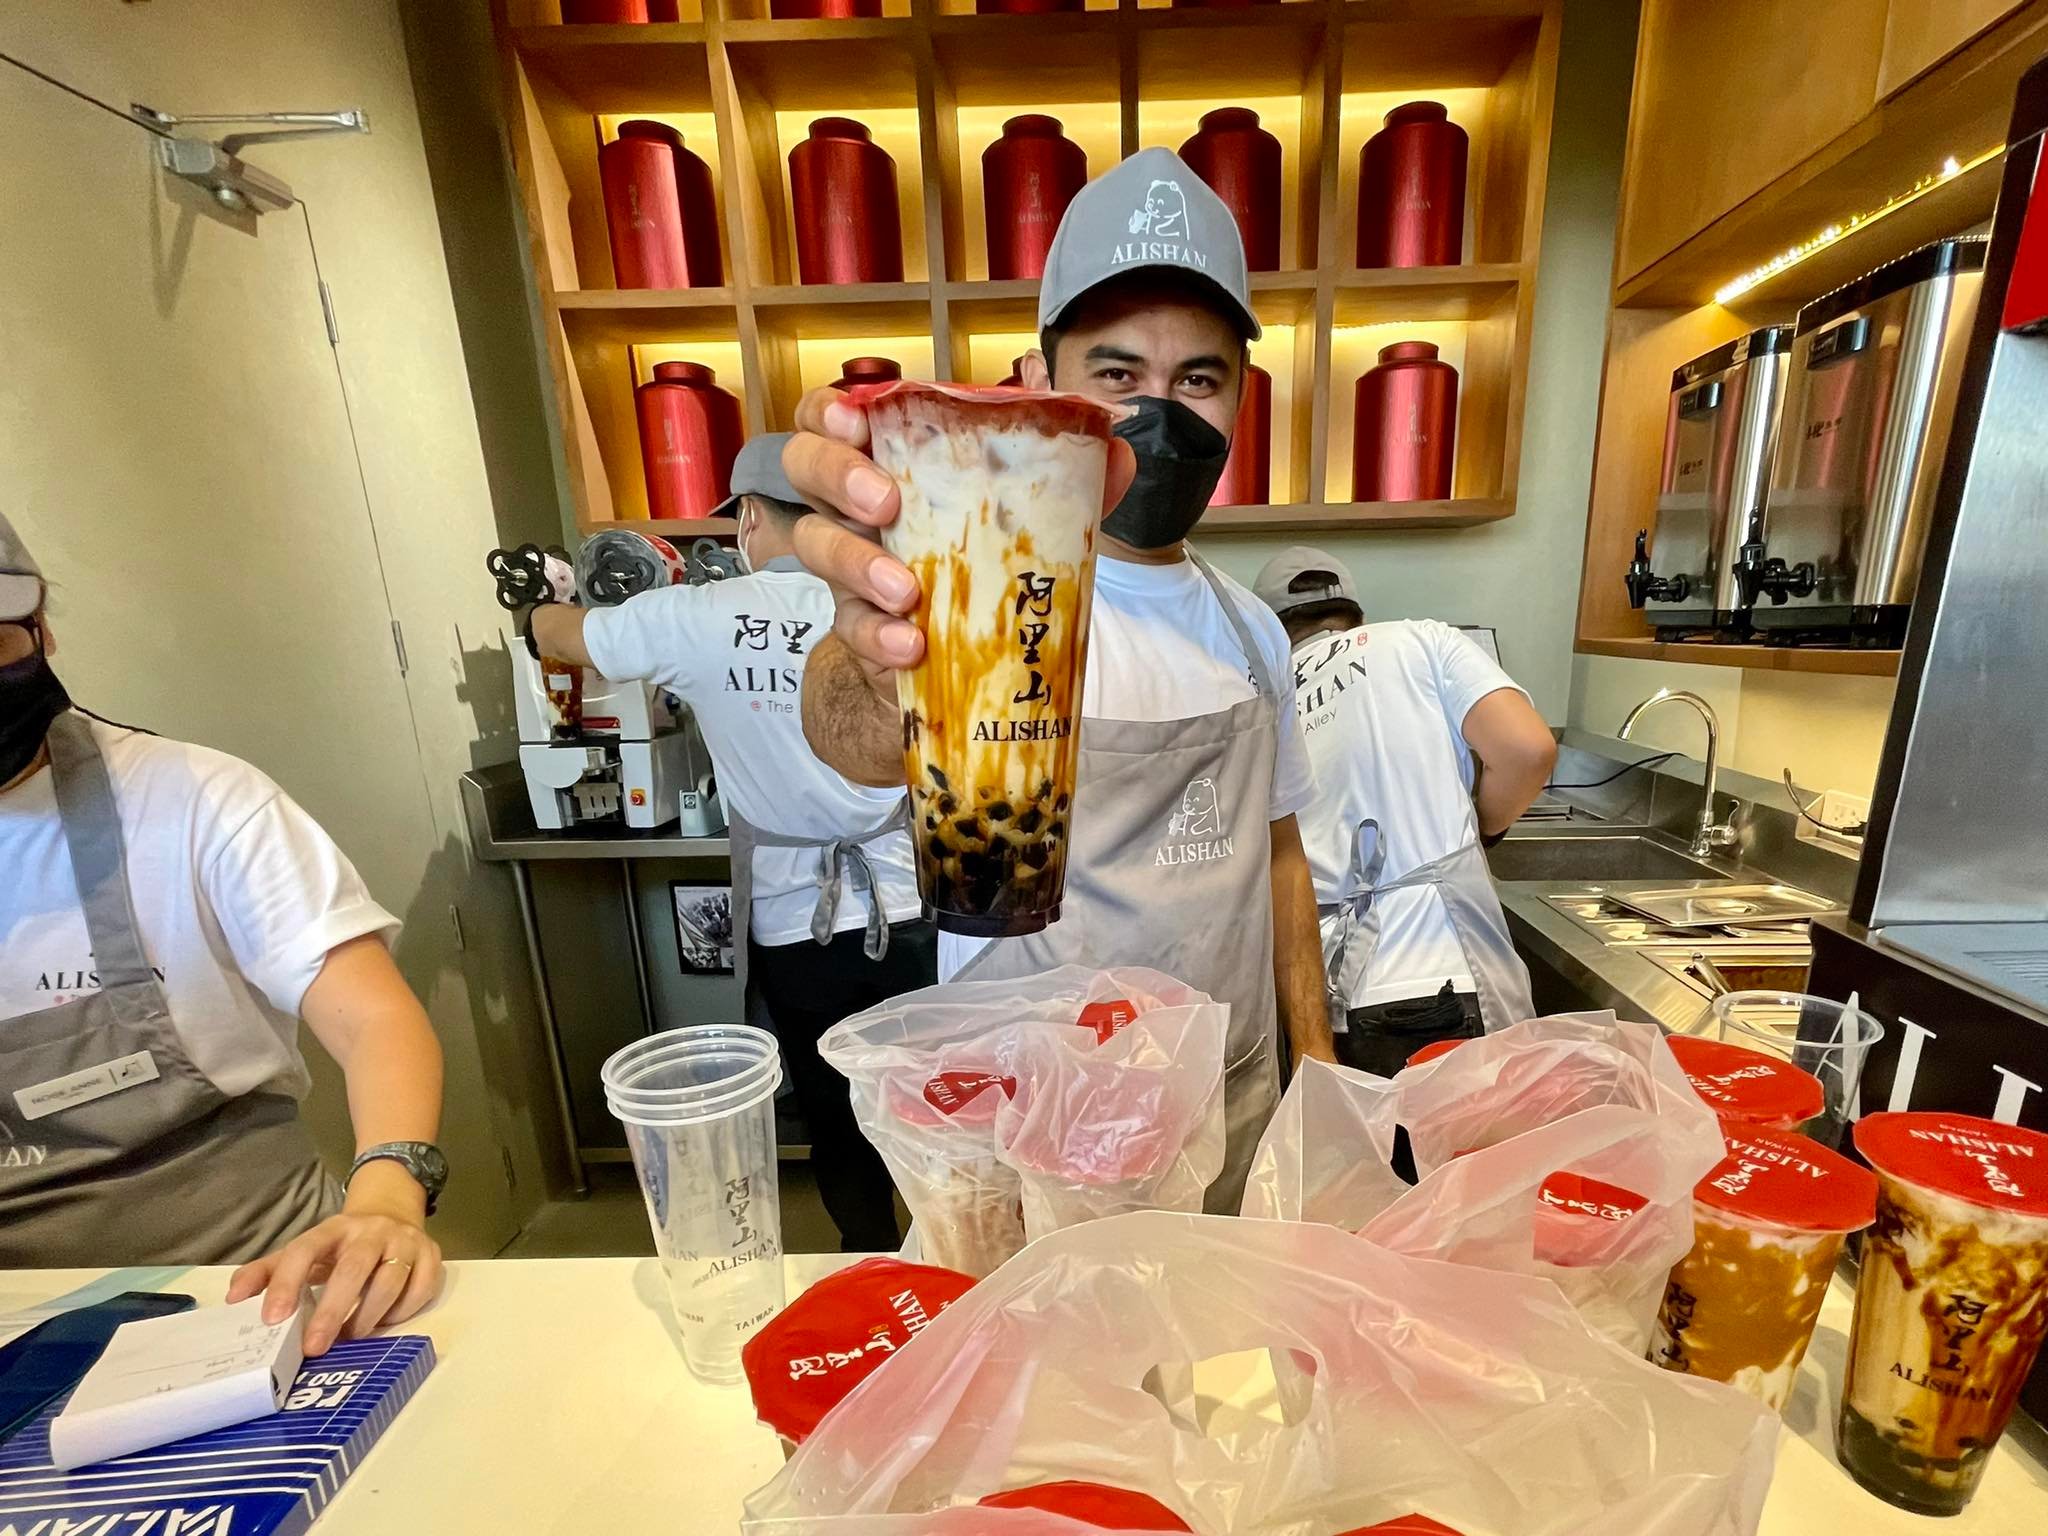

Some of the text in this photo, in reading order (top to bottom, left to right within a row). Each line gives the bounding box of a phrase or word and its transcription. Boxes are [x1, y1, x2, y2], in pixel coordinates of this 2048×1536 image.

[1111, 241, 1207, 269] ALISHAN
[1013, 571, 1056, 706] 阿里山
[724, 666, 799, 694] ALIS
[767, 700, 795, 713] The
[973, 716, 1073, 742] ALISHAN
[1304, 706, 1338, 736] Alley
[1154, 837, 1234, 866] ALISHAN
[35, 966, 166, 991] ALISN
[708, 1237, 776, 1275] ALISHAN
[735, 1305, 776, 1332] TAIWAN
[307, 1370, 363, 1387] 500
[1890, 1361, 1993, 1401] ALISHAN
[283, 1385, 353, 1410] re
